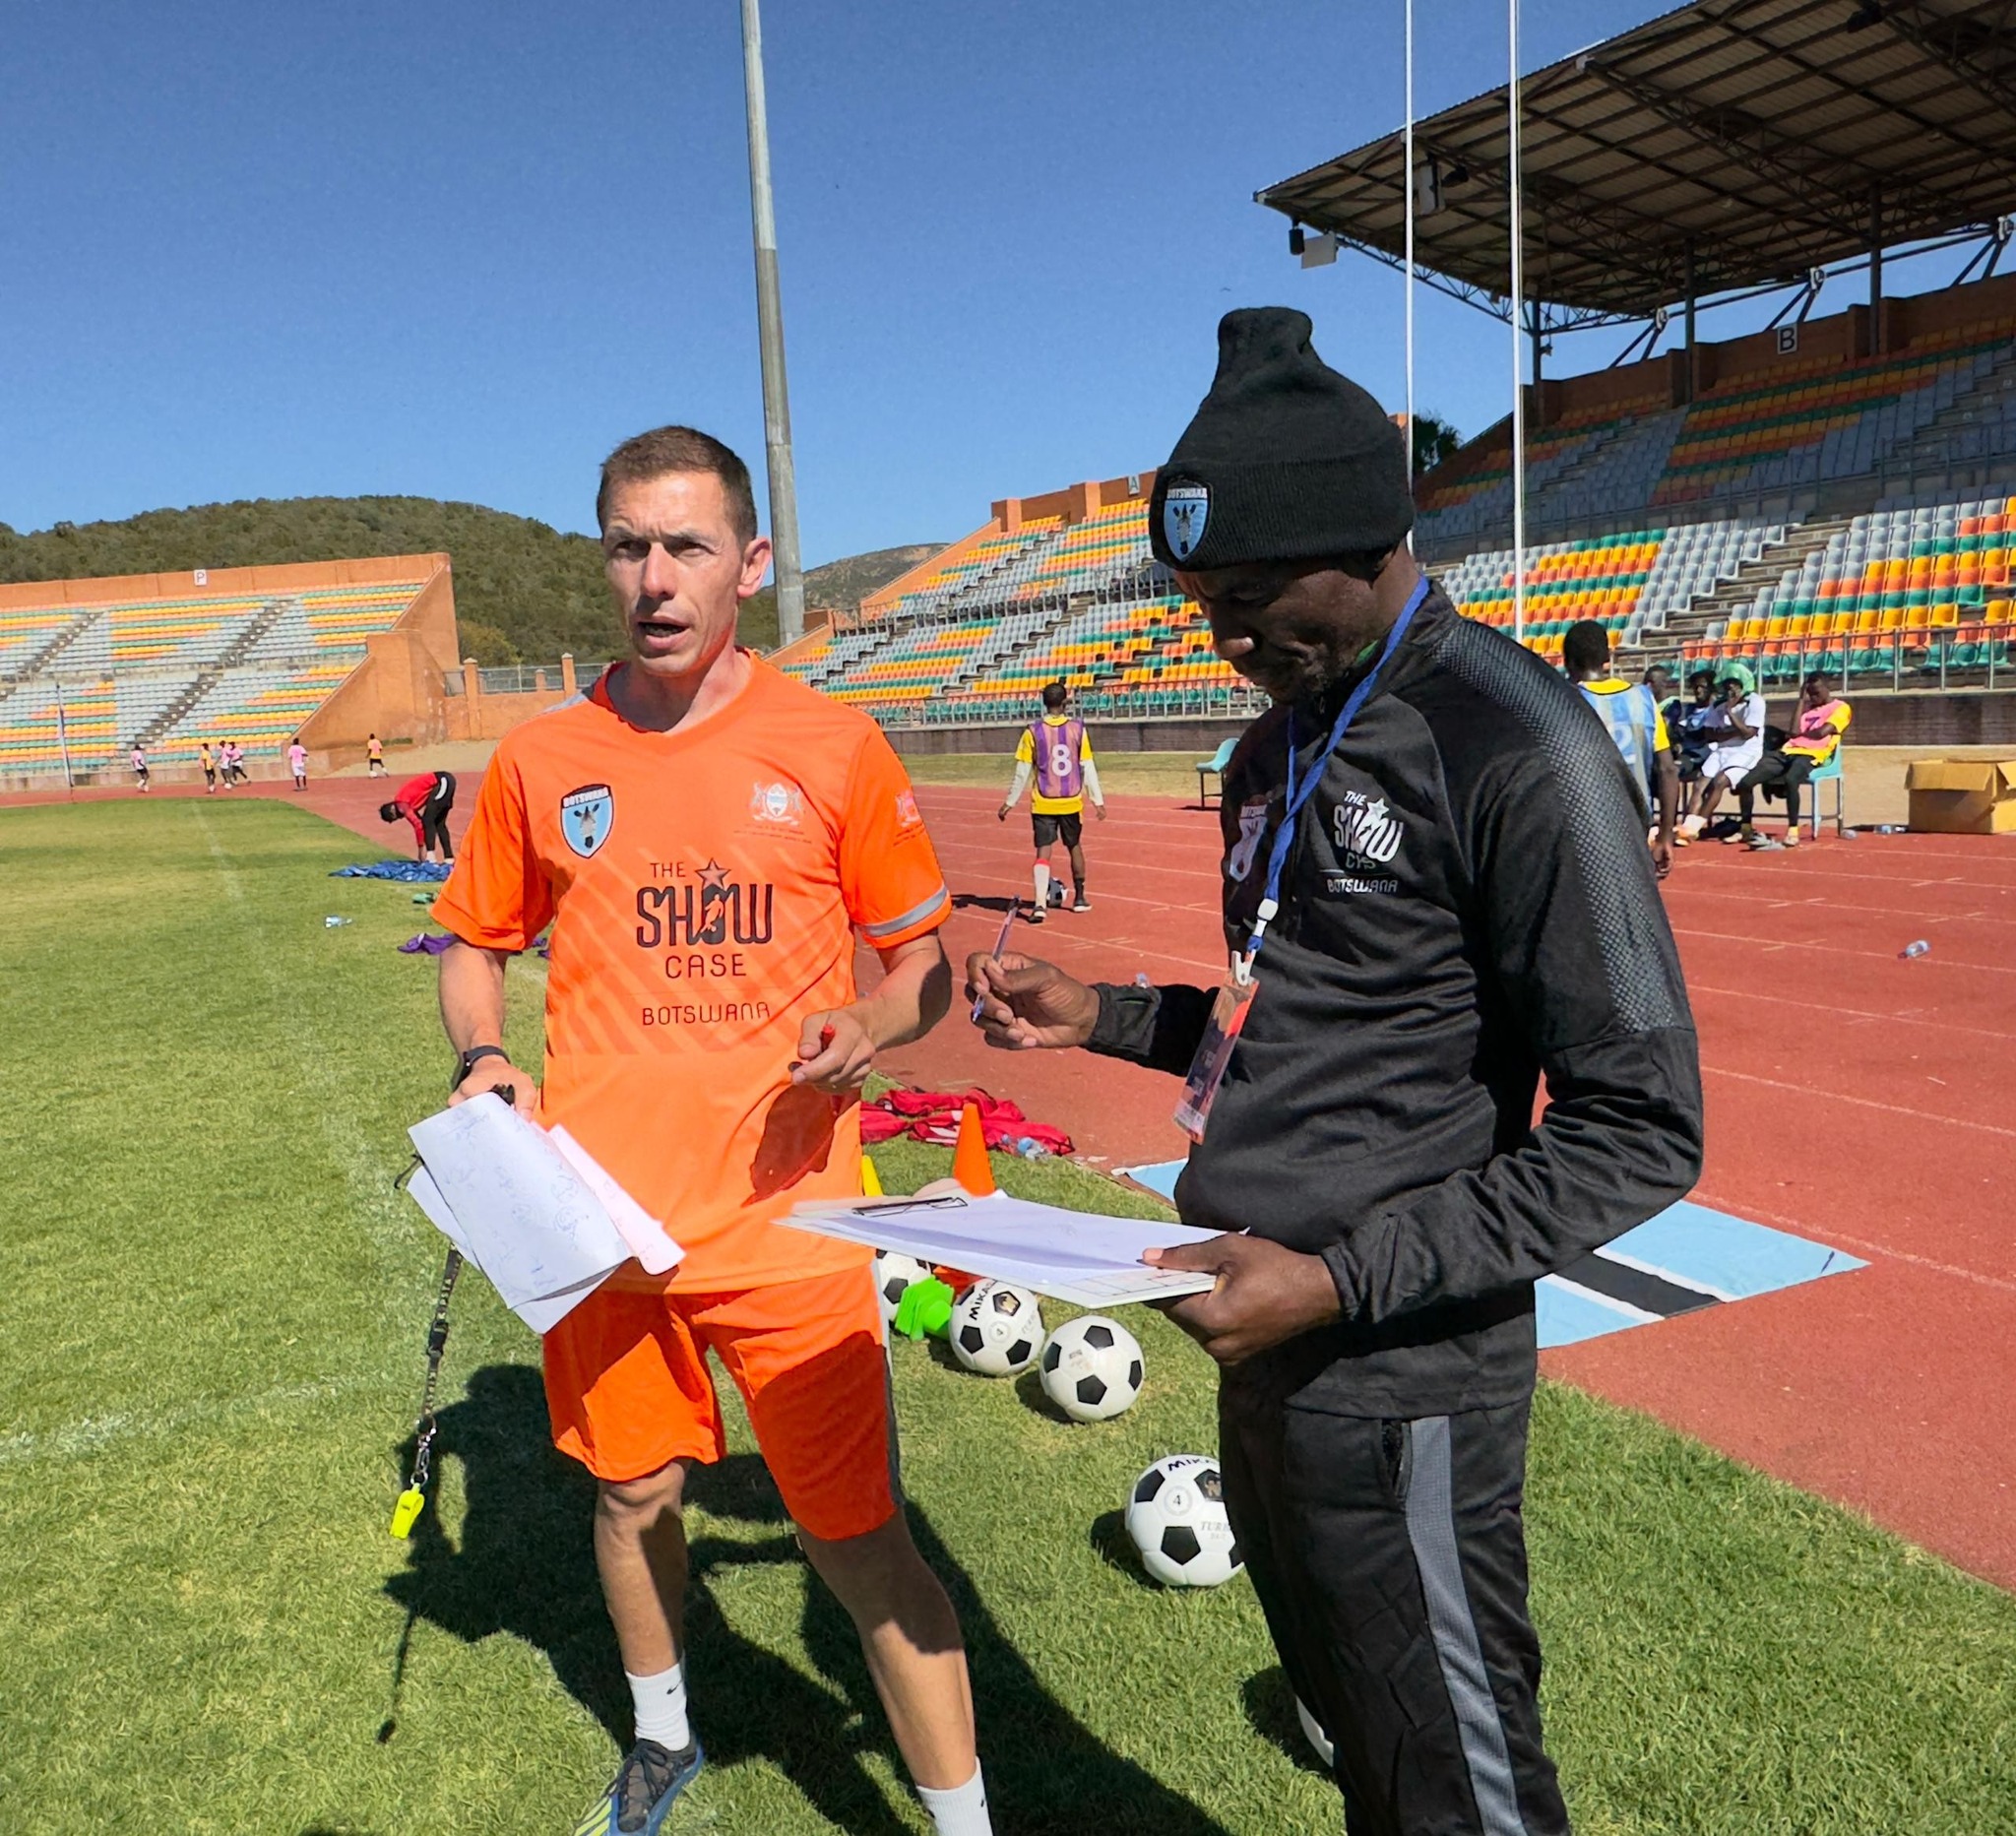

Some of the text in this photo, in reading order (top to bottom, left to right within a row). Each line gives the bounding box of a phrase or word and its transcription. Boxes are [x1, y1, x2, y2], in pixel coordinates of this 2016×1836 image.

[1051, 743, 1072, 777] 8
[1344, 791, 1367, 806] THE
[650, 862, 686, 878] THE
[636, 883, 773, 948] SHOW
[664, 953, 746, 979] CASE
[642, 1001, 771, 1026] BOTSWANA
[969, 1282, 993, 1321] MIKA
